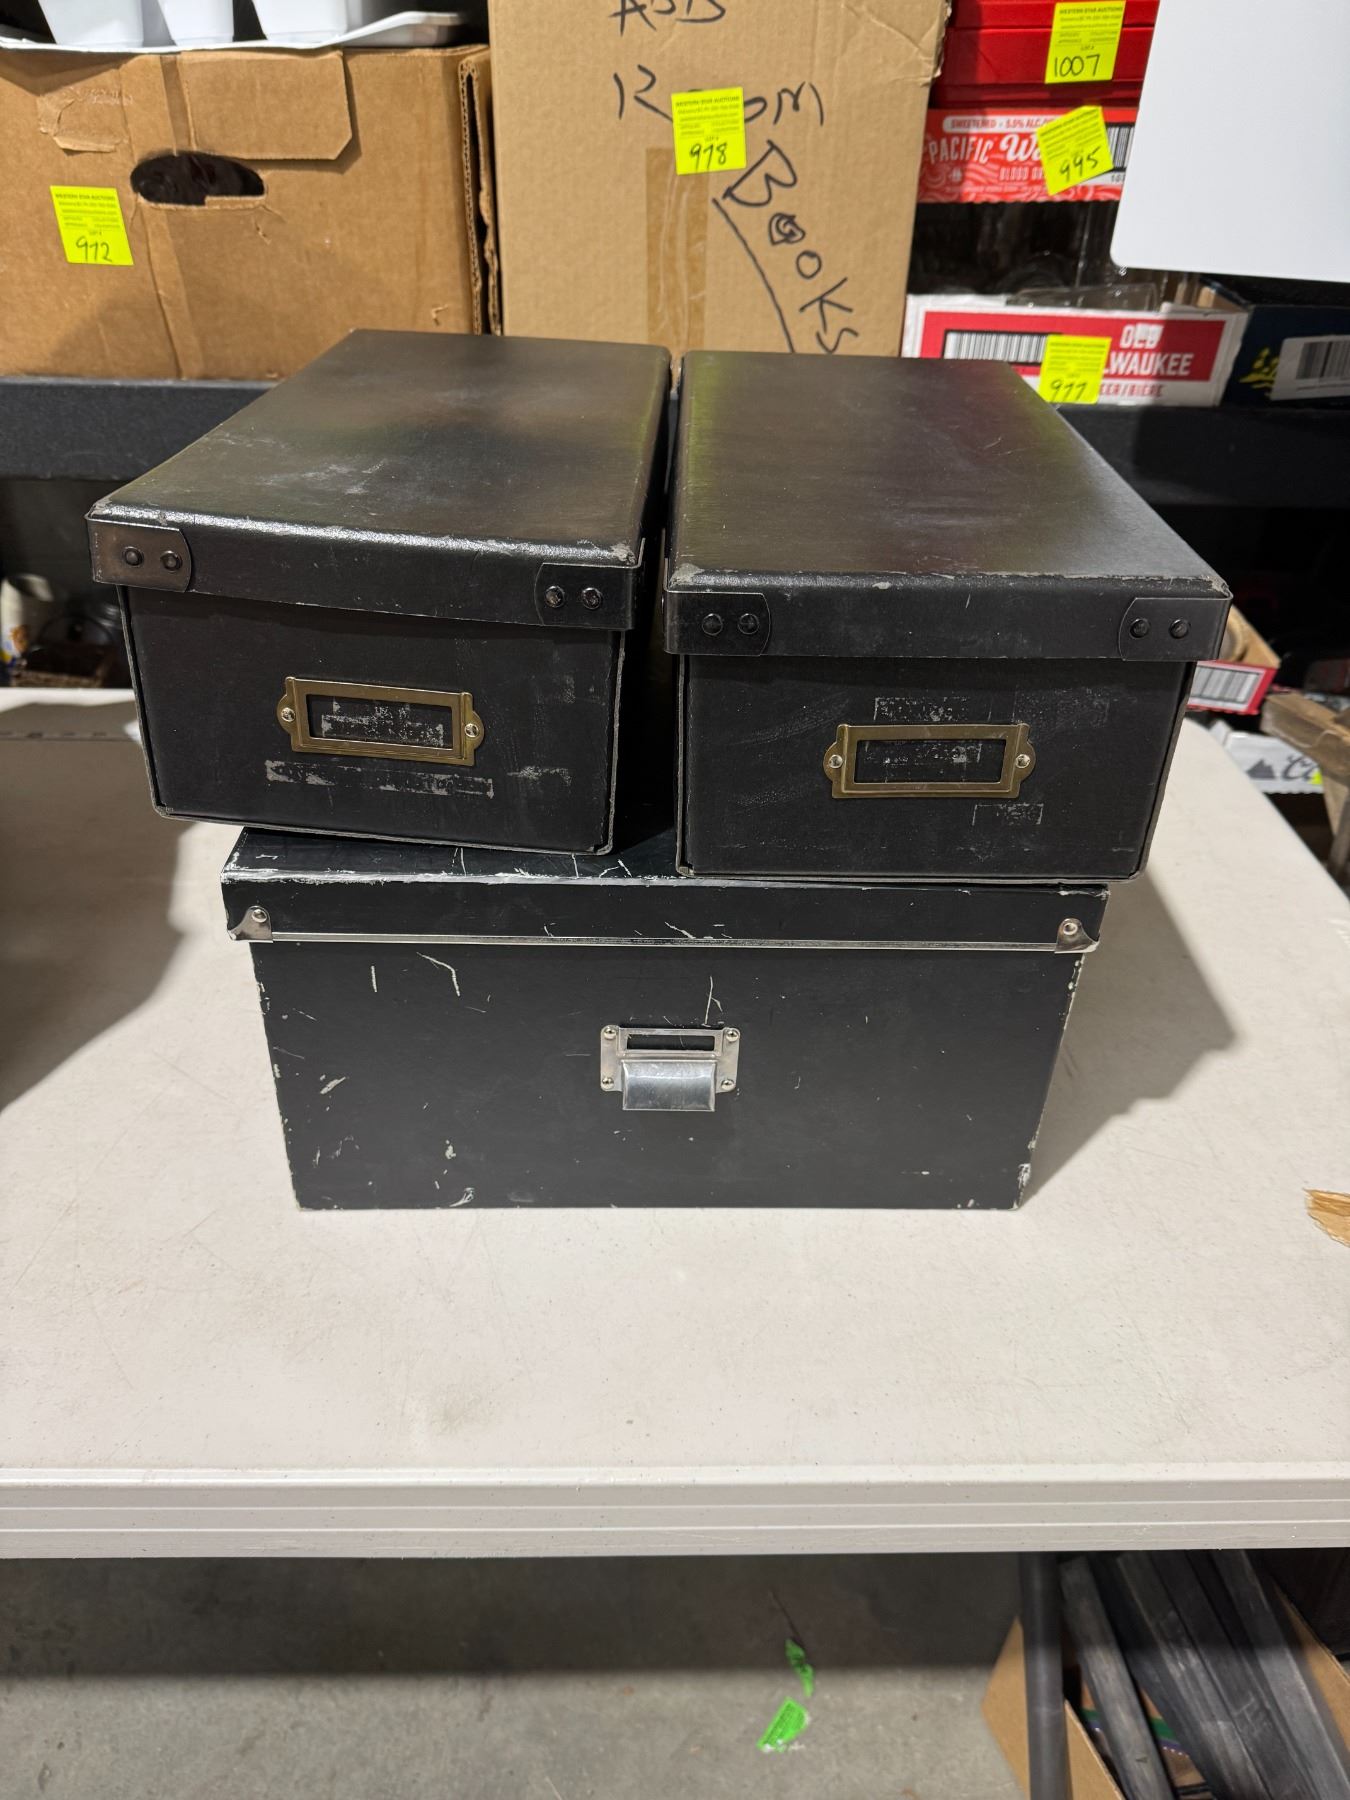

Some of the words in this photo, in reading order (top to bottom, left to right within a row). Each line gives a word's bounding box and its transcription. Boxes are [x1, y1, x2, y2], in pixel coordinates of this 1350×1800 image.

[1054, 53, 1100, 77] 1007
[689, 142, 727, 170] 978
[928, 136, 994, 165] PACIFIC
[1060, 146, 1100, 183] 995
[76, 236, 112, 262] 972
[1050, 379, 1087, 402] 977
